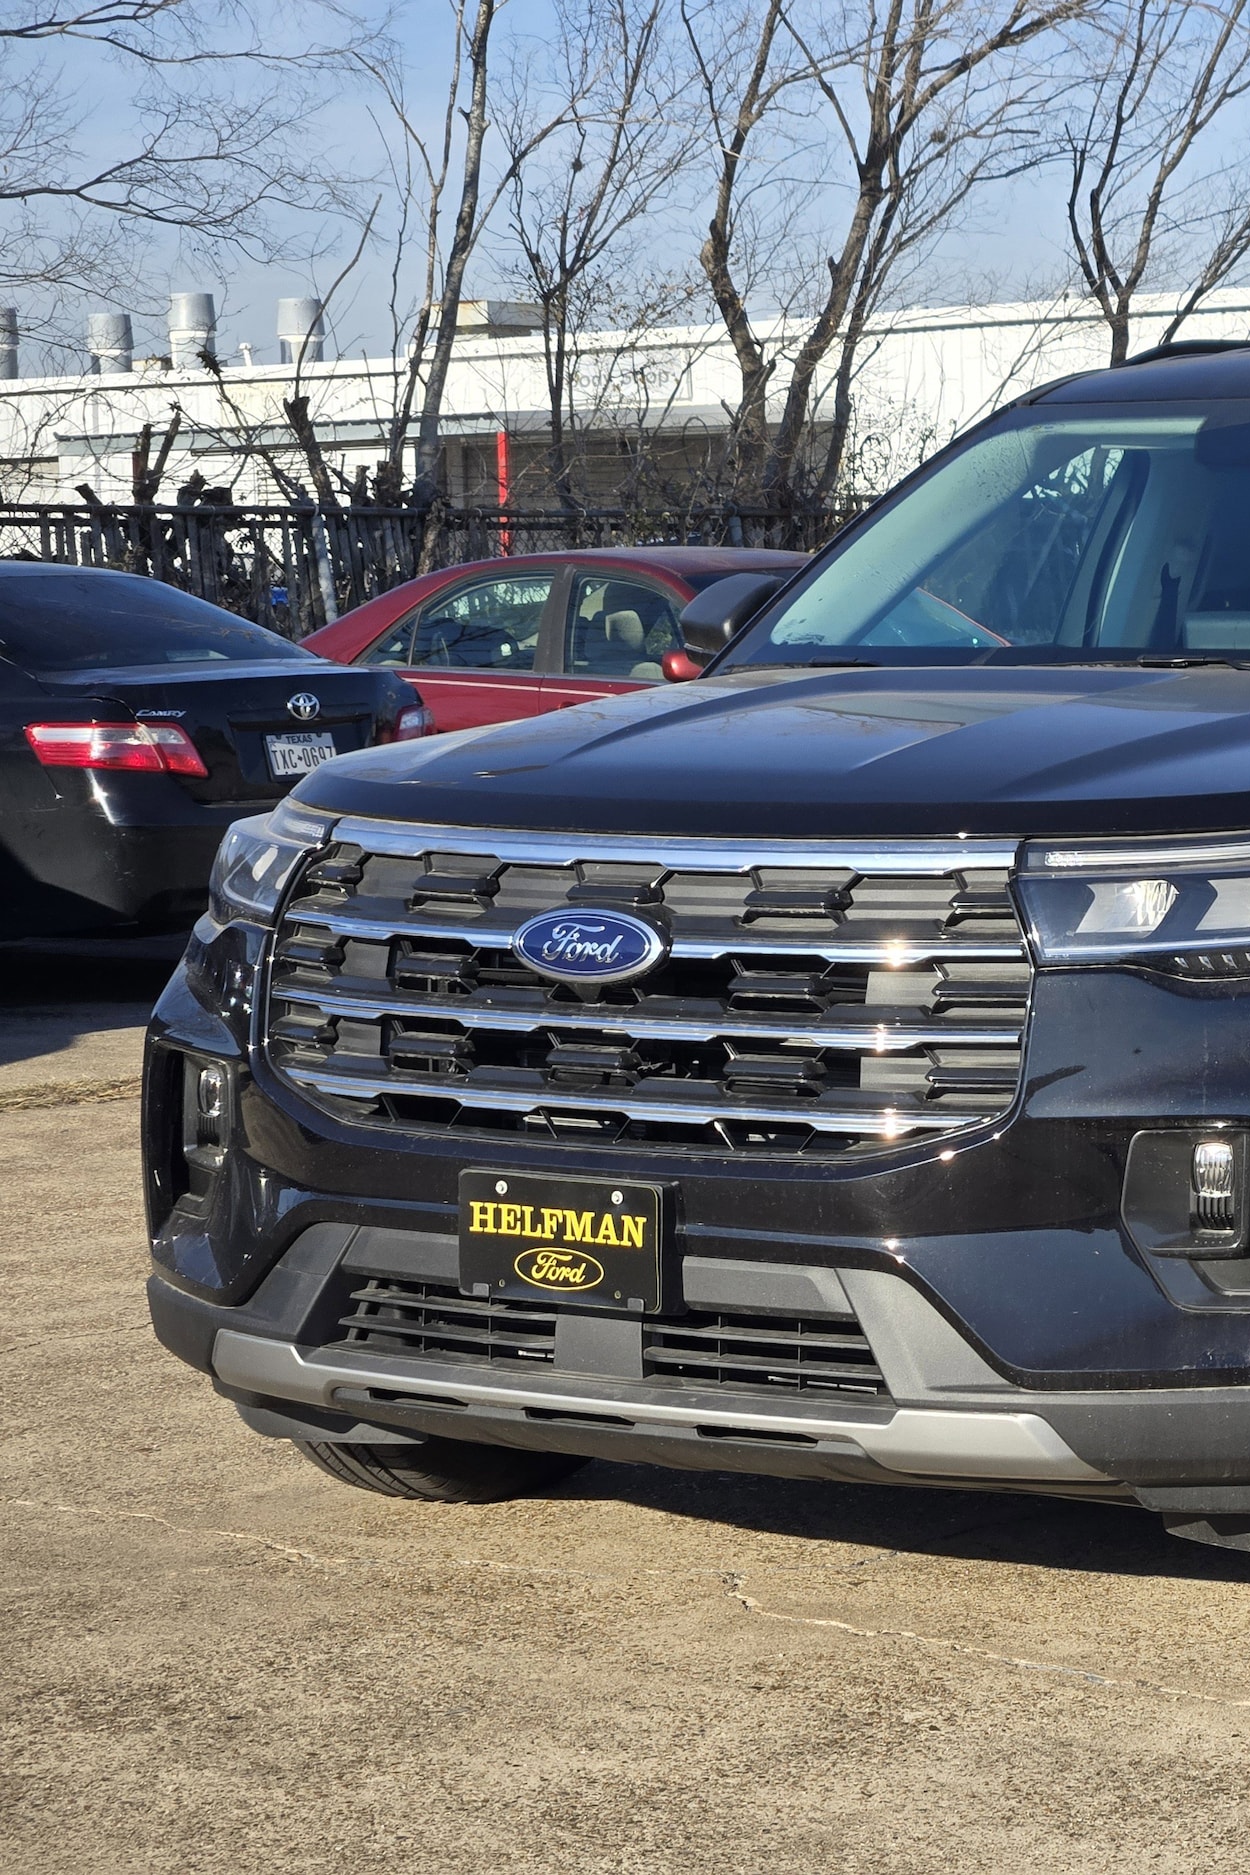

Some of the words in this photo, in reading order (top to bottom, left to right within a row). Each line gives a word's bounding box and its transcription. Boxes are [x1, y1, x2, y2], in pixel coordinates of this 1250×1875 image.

[620, 368, 670, 387] Sop
[285, 734, 314, 745] TEXAS
[541, 922, 625, 964] Ford
[468, 1200, 647, 1248] HELFMAN
[531, 1251, 587, 1284] Ford
